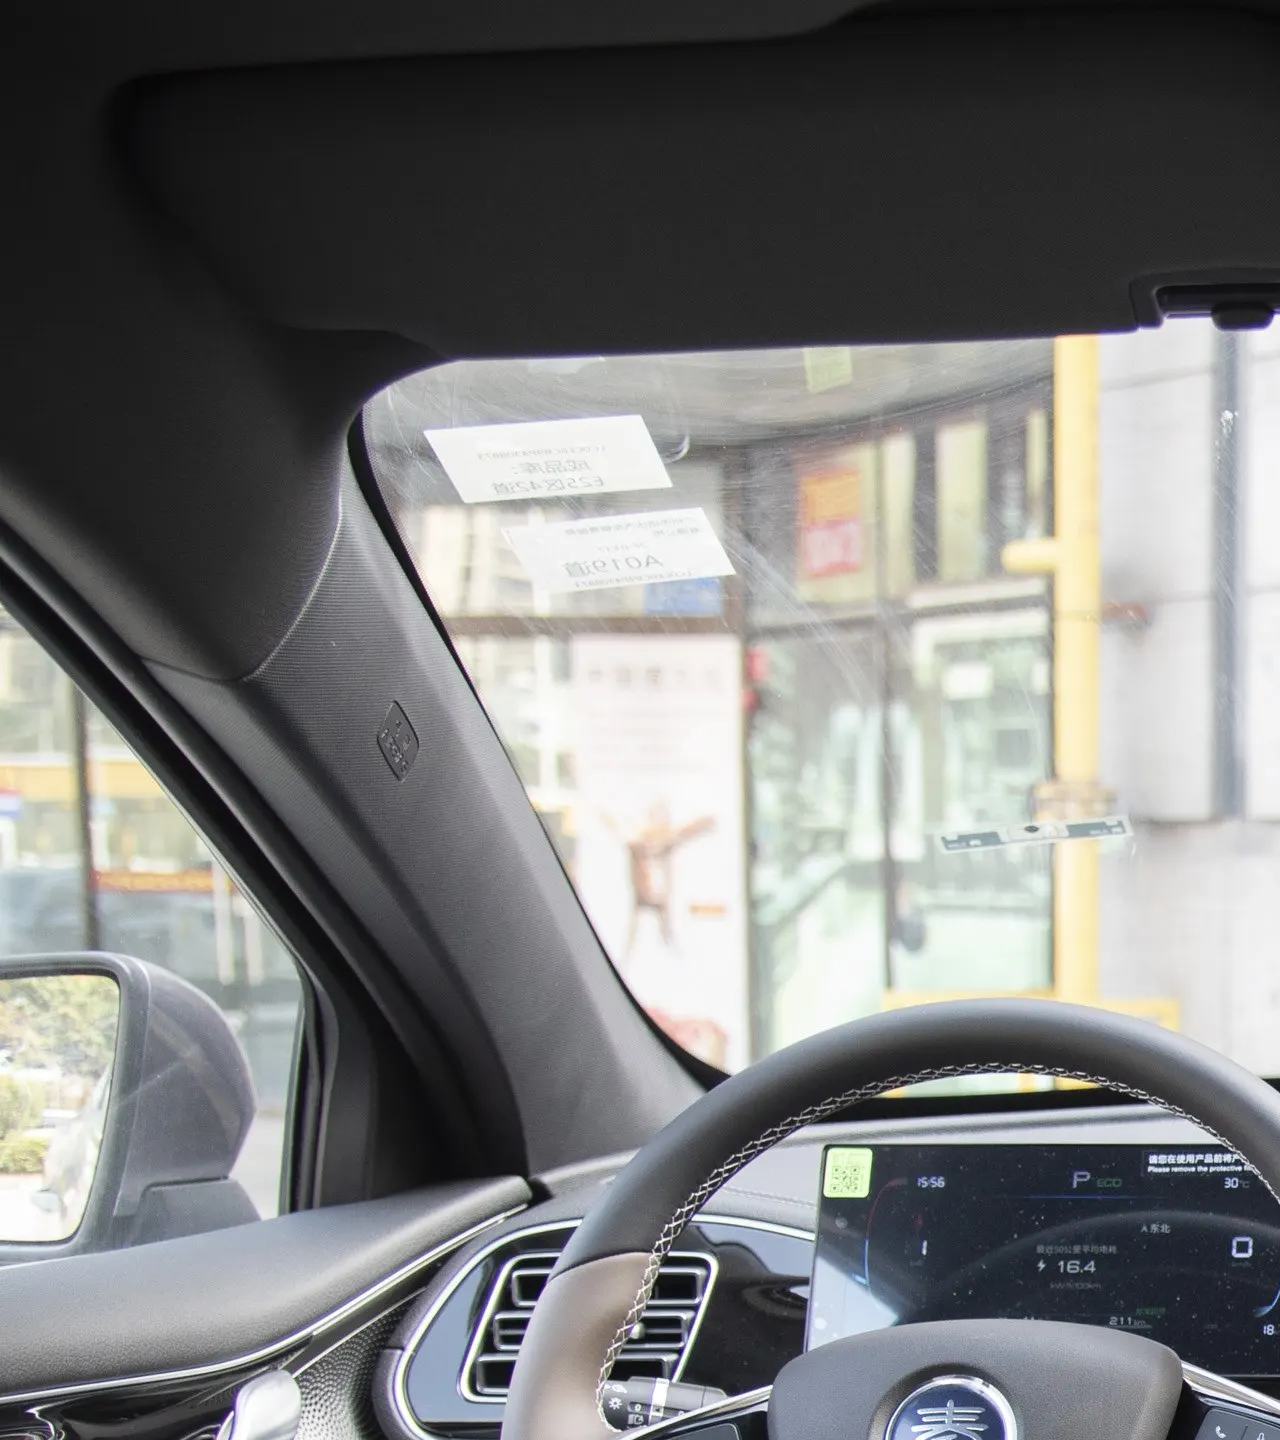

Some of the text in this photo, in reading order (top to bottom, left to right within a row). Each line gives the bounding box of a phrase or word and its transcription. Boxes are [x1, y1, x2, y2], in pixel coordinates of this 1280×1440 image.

[1148, 1165, 1170, 1173] Please
[1209, 1165, 1243, 1173] protective
[917, 1176, 946, 1188] 15:56
[1072, 1171, 1122, 1189] P ECO
[1231, 1236, 1253, 1258] 0
[1058, 1260, 1096, 1273] 16.4
[1108, 1316, 1132, 1326] 211
